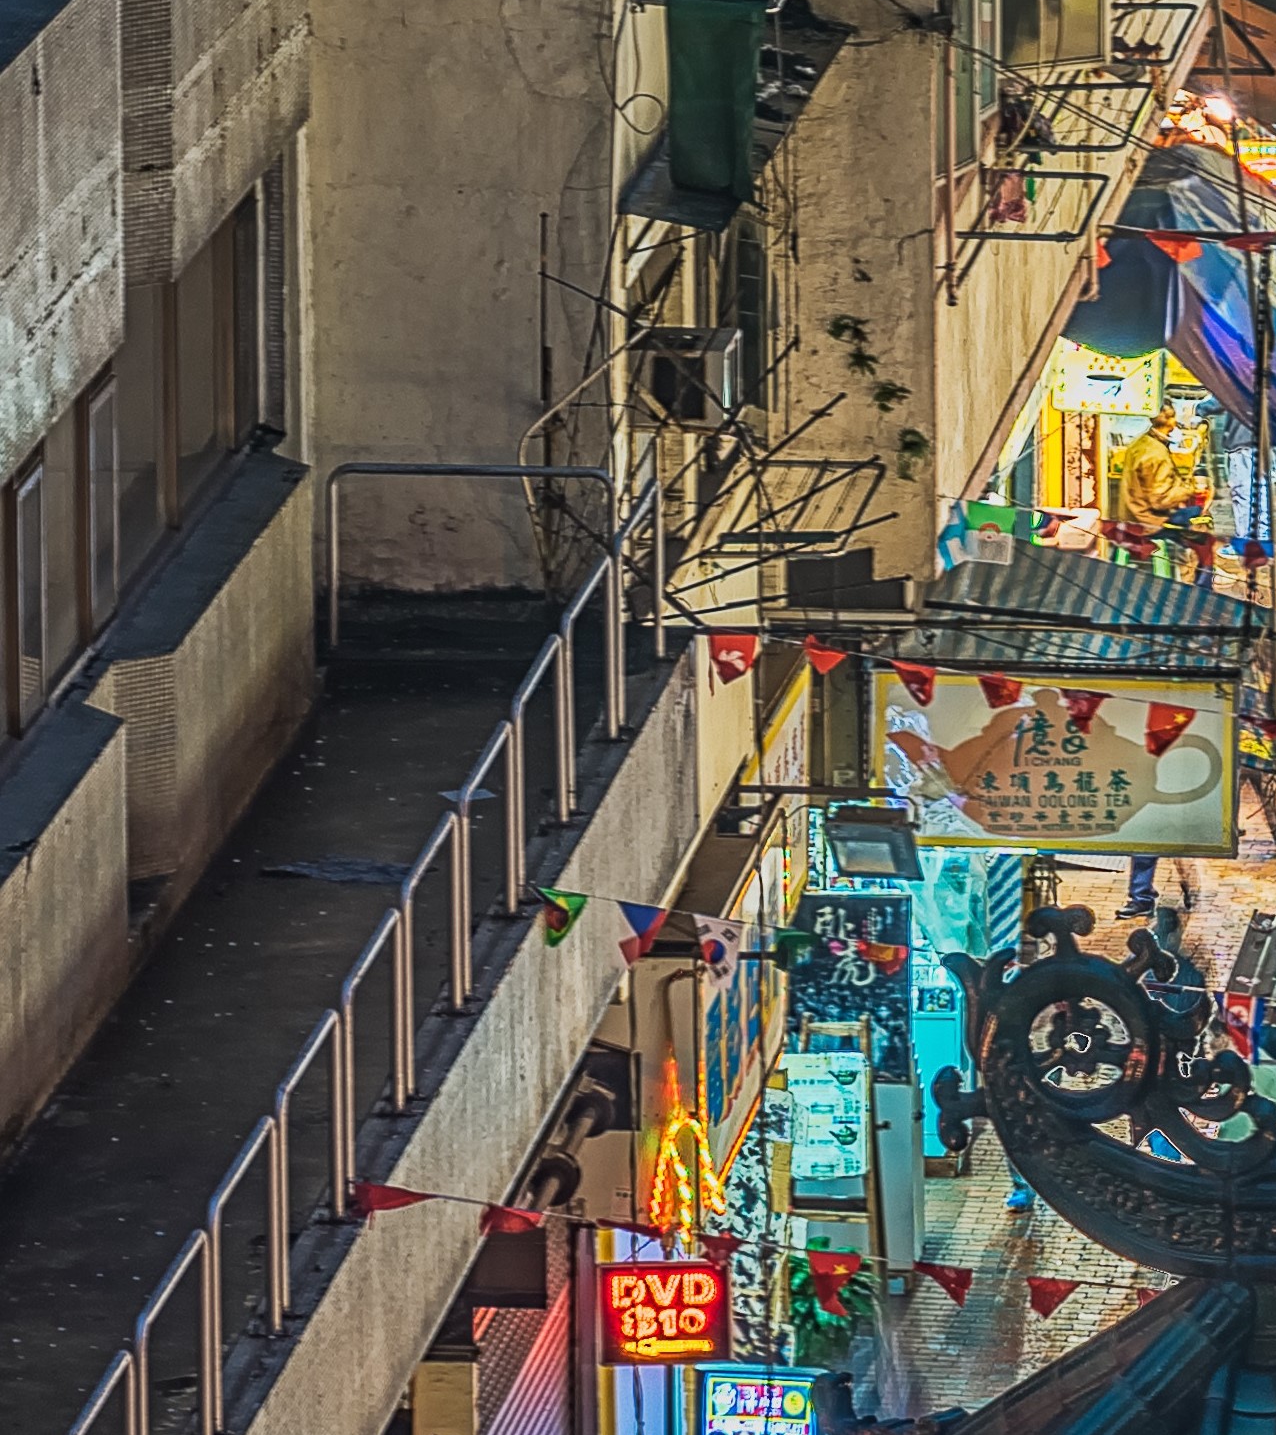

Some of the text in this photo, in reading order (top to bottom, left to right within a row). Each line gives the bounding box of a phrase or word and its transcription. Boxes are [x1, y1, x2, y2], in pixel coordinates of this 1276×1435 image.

[1037, 794, 1098, 808] OOLONG
[1104, 793, 1132, 807] TEA
[611, 1272, 718, 1309] DVD
